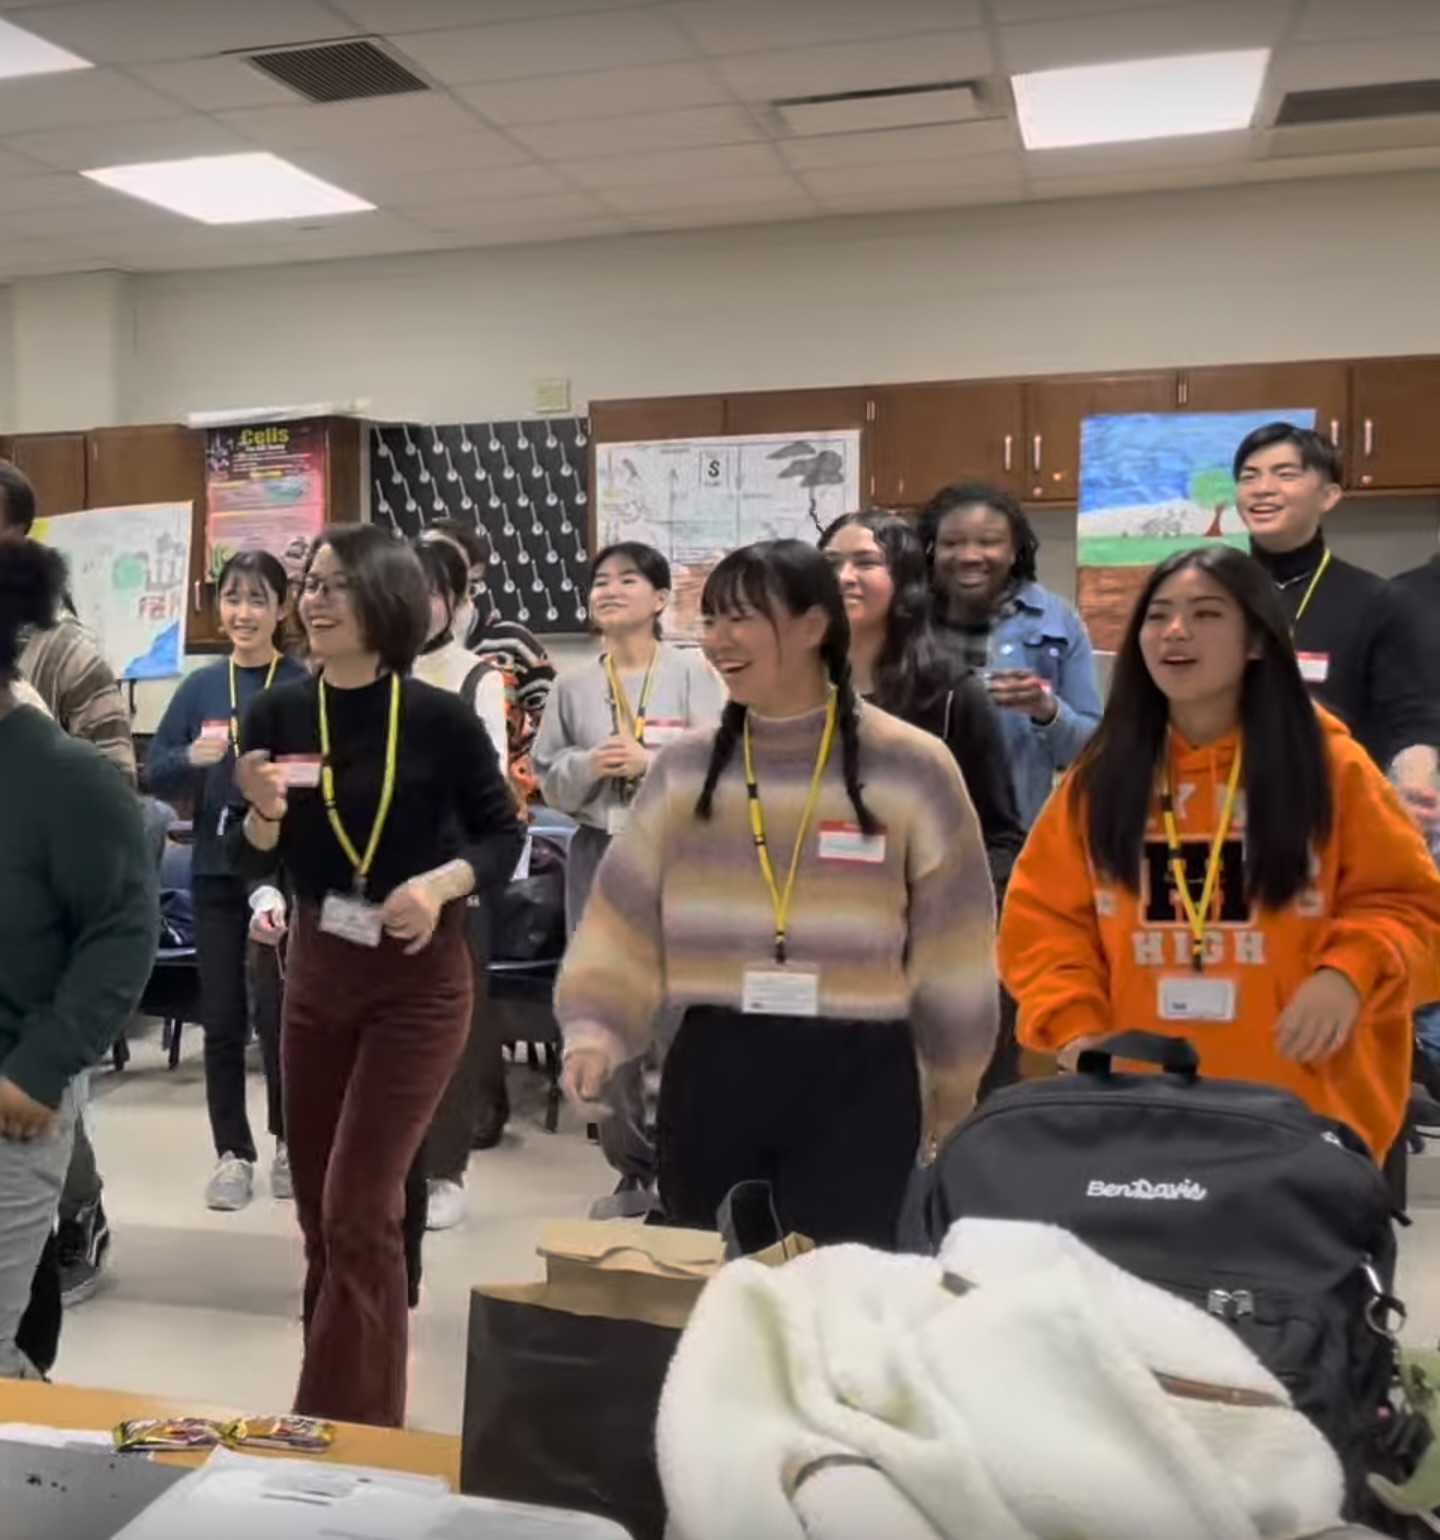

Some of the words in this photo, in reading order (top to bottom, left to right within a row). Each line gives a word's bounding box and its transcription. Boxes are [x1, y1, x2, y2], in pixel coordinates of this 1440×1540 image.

[241, 428, 290, 444] Cells
[708, 460, 721, 478] S
[1133, 931, 1265, 966] HIGH
